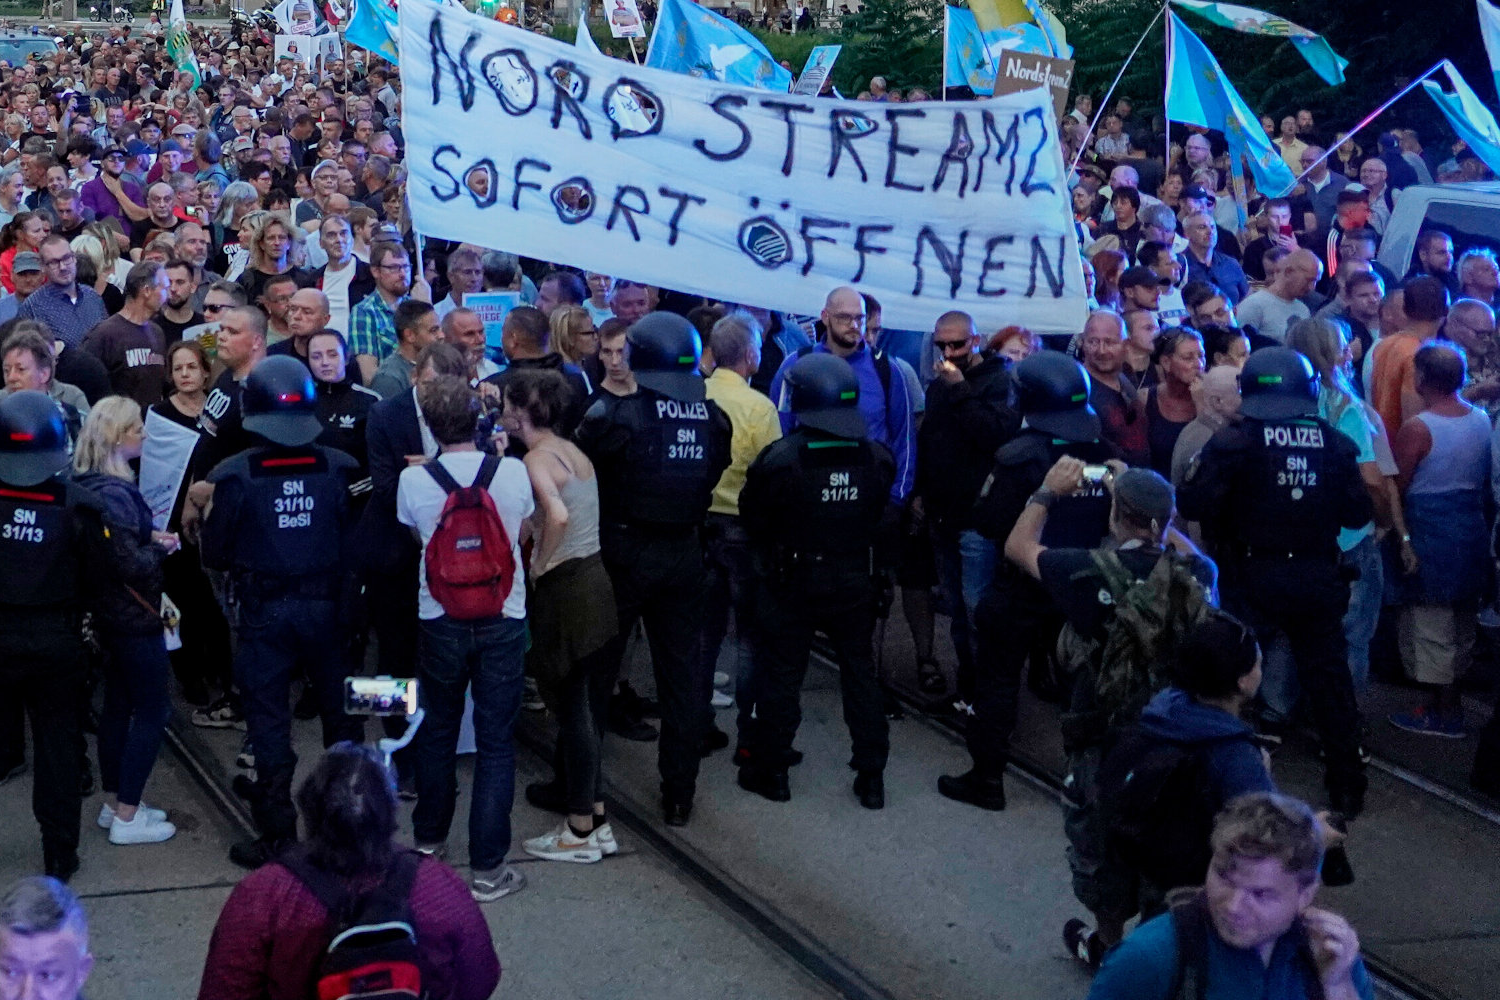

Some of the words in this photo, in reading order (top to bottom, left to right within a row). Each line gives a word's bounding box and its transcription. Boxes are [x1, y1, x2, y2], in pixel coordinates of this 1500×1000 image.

[429, 13, 665, 140] NORD
[430, 144, 706, 246] SOFORT
[739, 195, 1067, 299] ÖFFNEN
[656, 400, 709, 420] POLIZEI
[677, 428, 696, 443] SN
[1263, 425, 1324, 448] POLIZEI
[668, 444, 704, 460] 31/12
[1286, 456, 1308, 471] SN
[829, 472, 850, 487] SN
[1277, 471, 1317, 486] 31/12
[282, 480, 305, 496] SN
[821, 486, 859, 502] 31/12
[274, 495, 315, 513] 31/10
[13, 508, 36, 525] SN
[2, 523, 44, 543] 31/13
